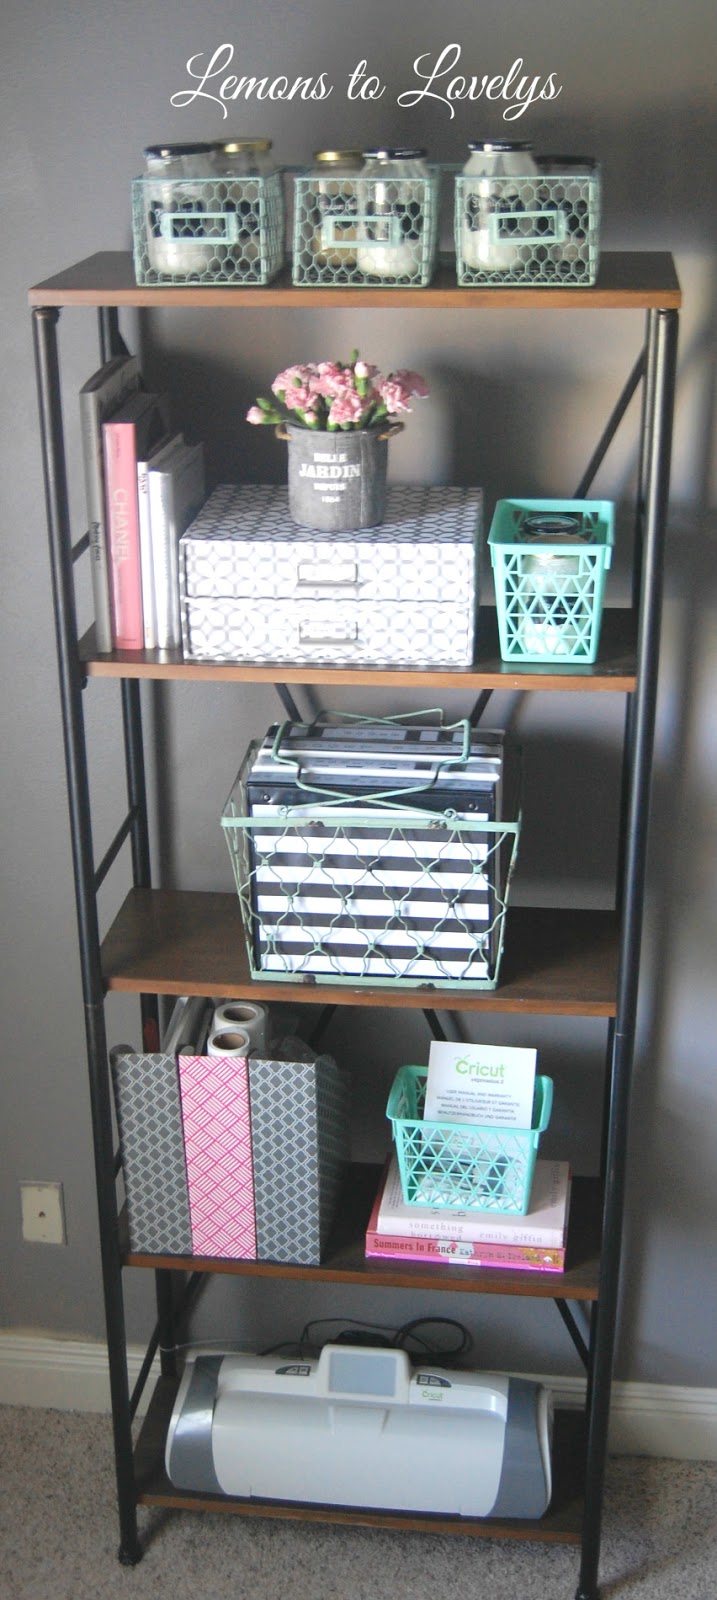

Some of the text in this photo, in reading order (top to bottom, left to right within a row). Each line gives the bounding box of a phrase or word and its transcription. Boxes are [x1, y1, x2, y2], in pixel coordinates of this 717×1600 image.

[299, 463, 361, 479] JARDIN
[112, 488, 130, 564] CHANEL
[455, 1057, 505, 1078] Cricut
[408, 1222, 464, 1234] something
[479, 1231, 543, 1244] emily giffin
[373, 1239, 413, 1251] Summers
[427, 1243, 456, 1254] France
